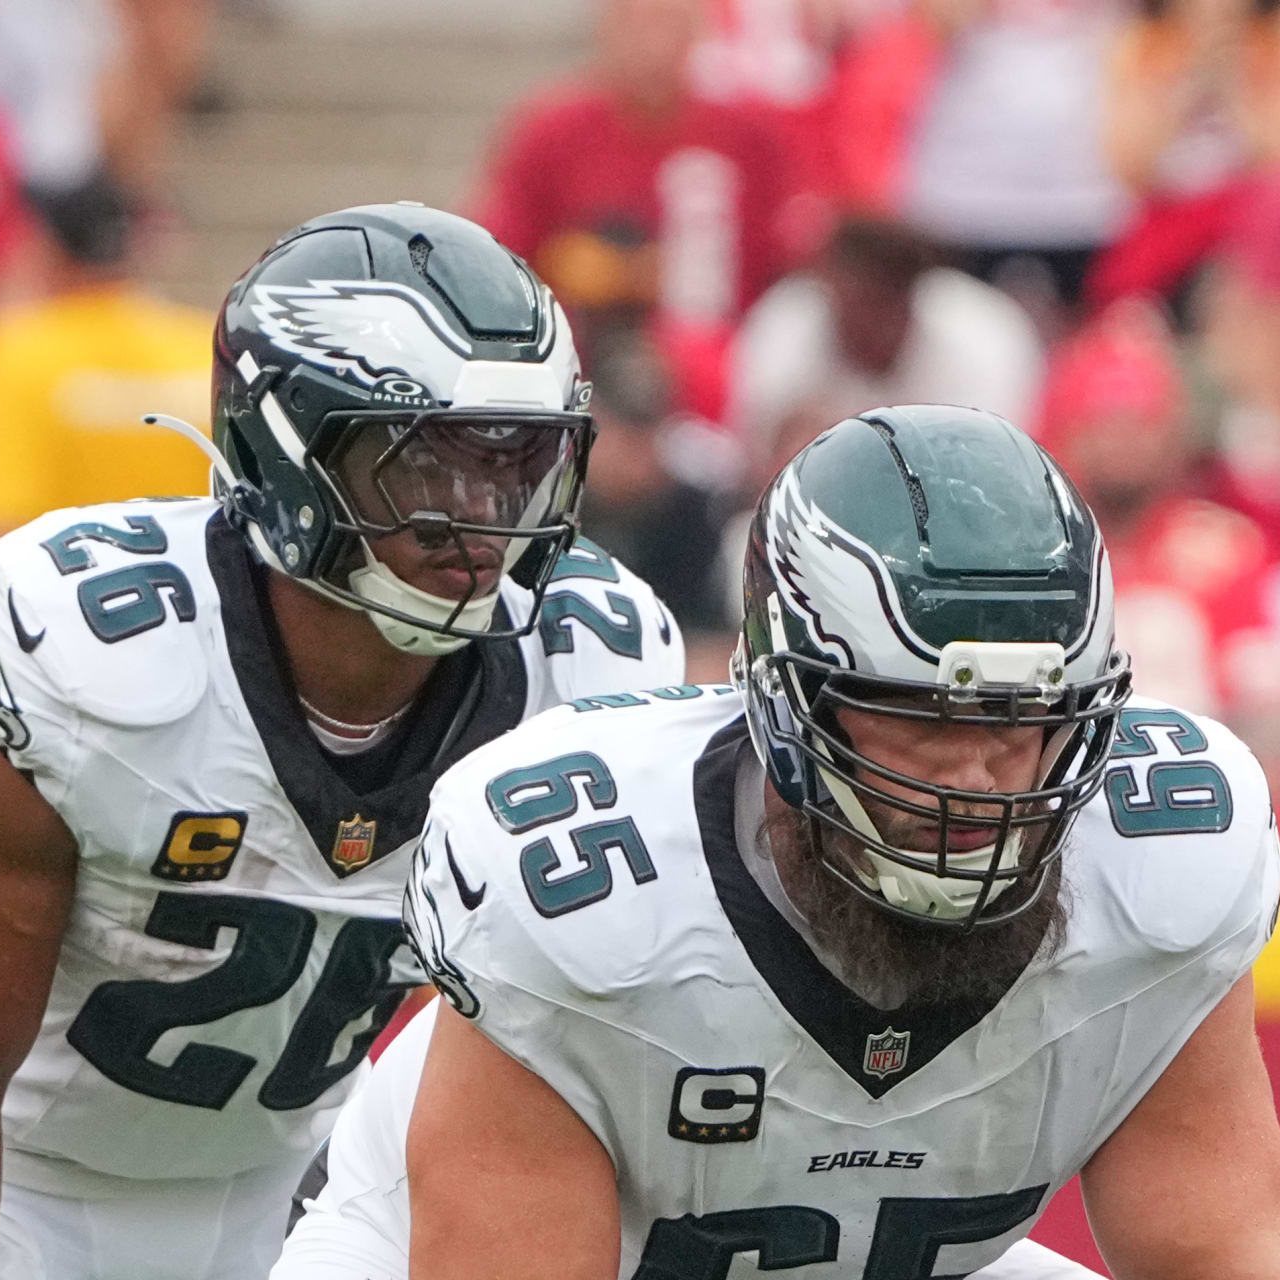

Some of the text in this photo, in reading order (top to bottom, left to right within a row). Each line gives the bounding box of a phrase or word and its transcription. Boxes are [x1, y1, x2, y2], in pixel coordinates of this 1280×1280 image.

[373, 392, 431, 406] OAKLEY
[39, 515, 198, 645] 26
[167, 817, 241, 865] C
[338, 840, 368, 860] NFL
[485, 750, 658, 919] 65
[871, 1050, 900, 1070] NFL
[679, 1074, 758, 1124] C
[807, 1150, 928, 1173] EAGLES
